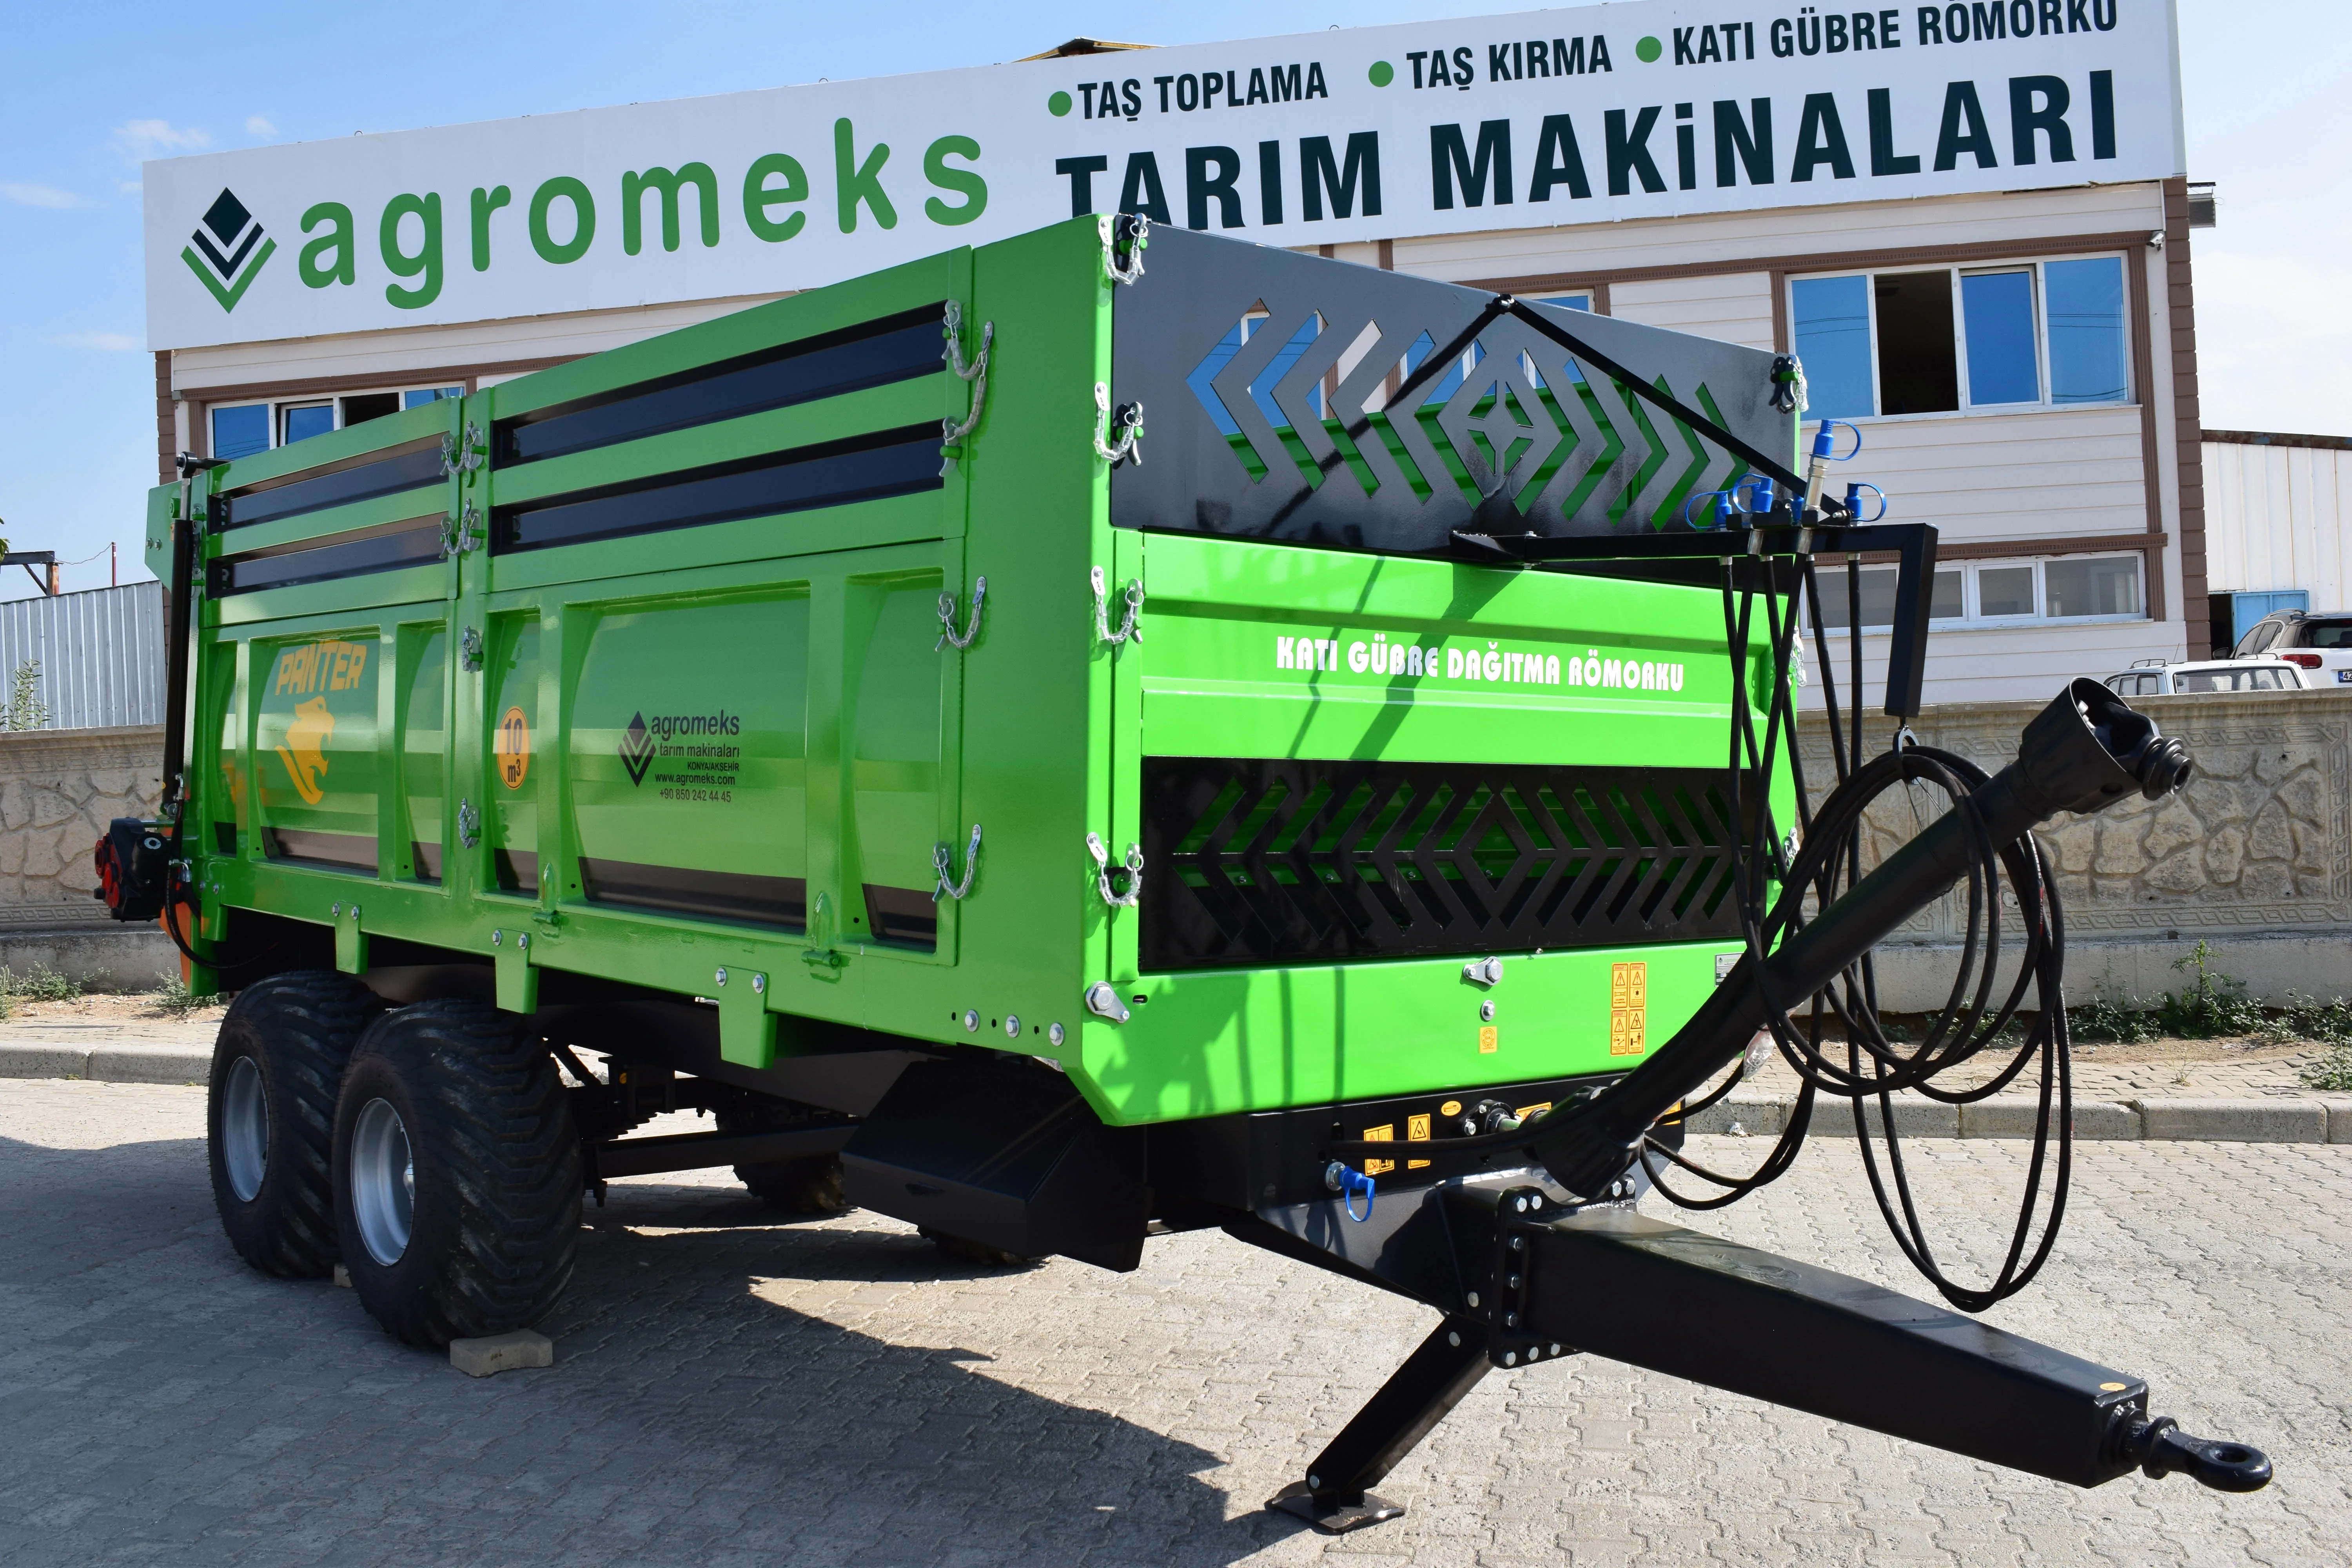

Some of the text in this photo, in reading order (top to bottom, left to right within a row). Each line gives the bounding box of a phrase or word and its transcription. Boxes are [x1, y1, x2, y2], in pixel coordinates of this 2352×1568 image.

[1406, 34, 1612, 91] TAŞ KIRMA
[1673, 22, 1754, 65] KATI
[1770, 7, 1900, 58] GÜBRE
[1078, 62, 1328, 122] TAŞ TOPLAMA
[1056, 131, 1382, 230] TARIM
[299, 118, 988, 310] agromeks
[275, 639, 367, 695] PANTER
[1277, 633, 1684, 691] KATI GÜBRE DAĞITMA RÖMORKU
[505, 718, 522, 755] 10
[651, 709, 740, 741] agromeks
[660, 743, 739, 758] tarım makinaları
[655, 773, 735, 786] www.agromeks.com
[660, 788, 731, 802] +90 850 242 44 45
